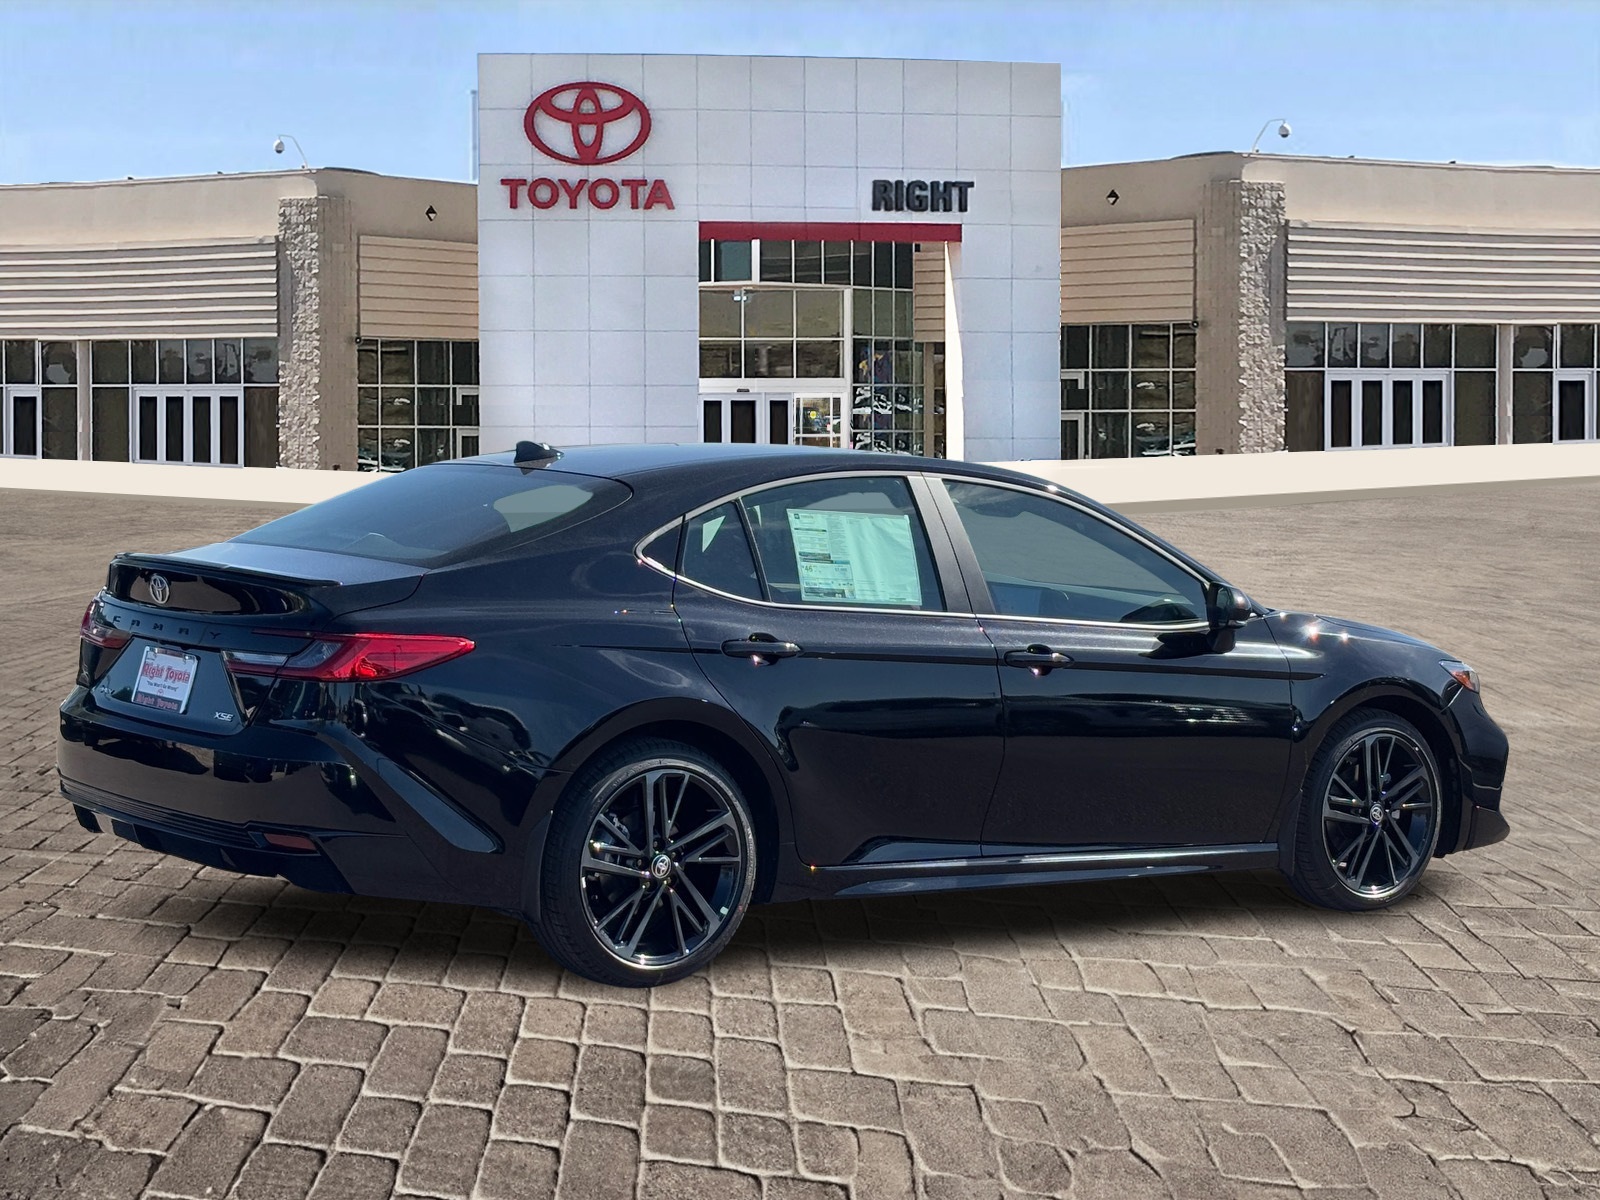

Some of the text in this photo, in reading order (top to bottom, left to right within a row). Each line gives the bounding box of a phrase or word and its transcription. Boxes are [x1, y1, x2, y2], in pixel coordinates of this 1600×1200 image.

[500, 177, 675, 210] TOYOTA
[872, 180, 975, 212] RIGHT
[112, 615, 221, 640] CAMRY
[141, 662, 191, 684] Right Toyota
[136, 693, 179, 710] Right Toyota
[213, 711, 234, 722] XSE
